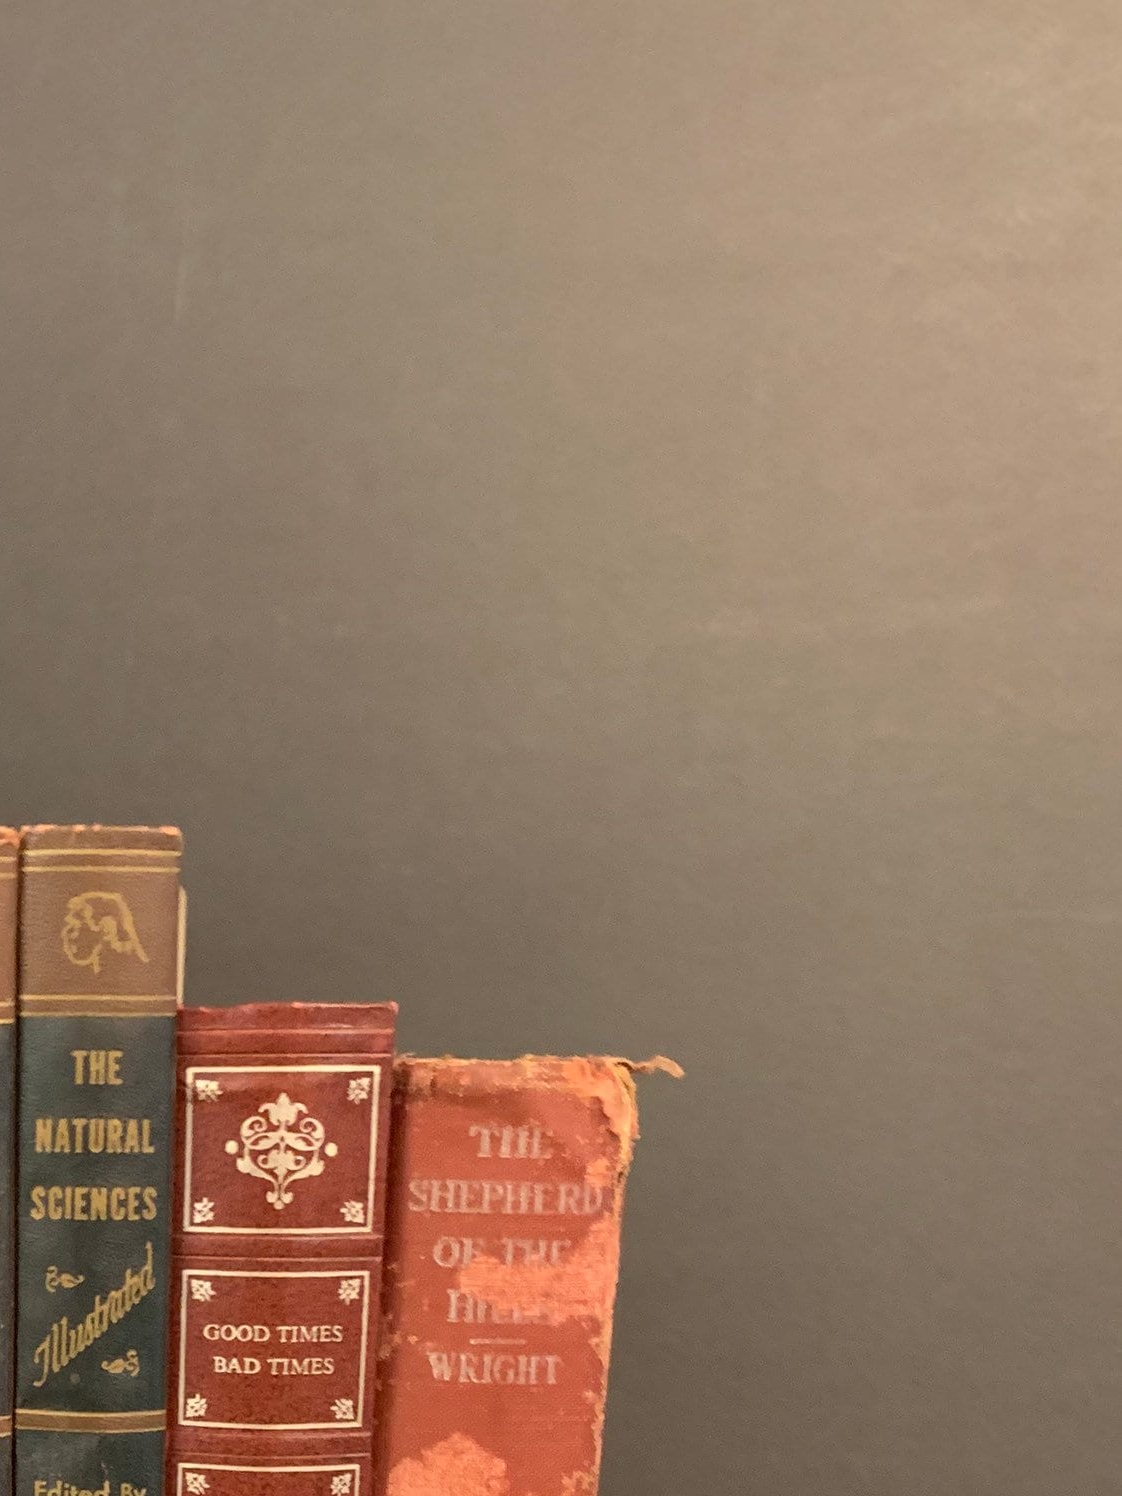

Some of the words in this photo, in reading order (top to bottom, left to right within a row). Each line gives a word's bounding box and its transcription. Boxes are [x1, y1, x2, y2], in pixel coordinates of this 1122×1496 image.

[71, 1049, 125, 1086] THE
[34, 1117, 156, 1154] NATURAL
[467, 1122, 555, 1161] THE
[29, 1185, 159, 1222] SCIENCES
[407, 1177, 604, 1216] SHEPHERD
[32, 1240, 157, 1388] Illustrated
[202, 1323, 271, 1343] GOOD
[275, 1325, 344, 1344] TIMES
[212, 1355, 262, 1375] BAD
[266, 1357, 336, 1376] TIMES
[427, 1350, 564, 1386] WRIGHT
